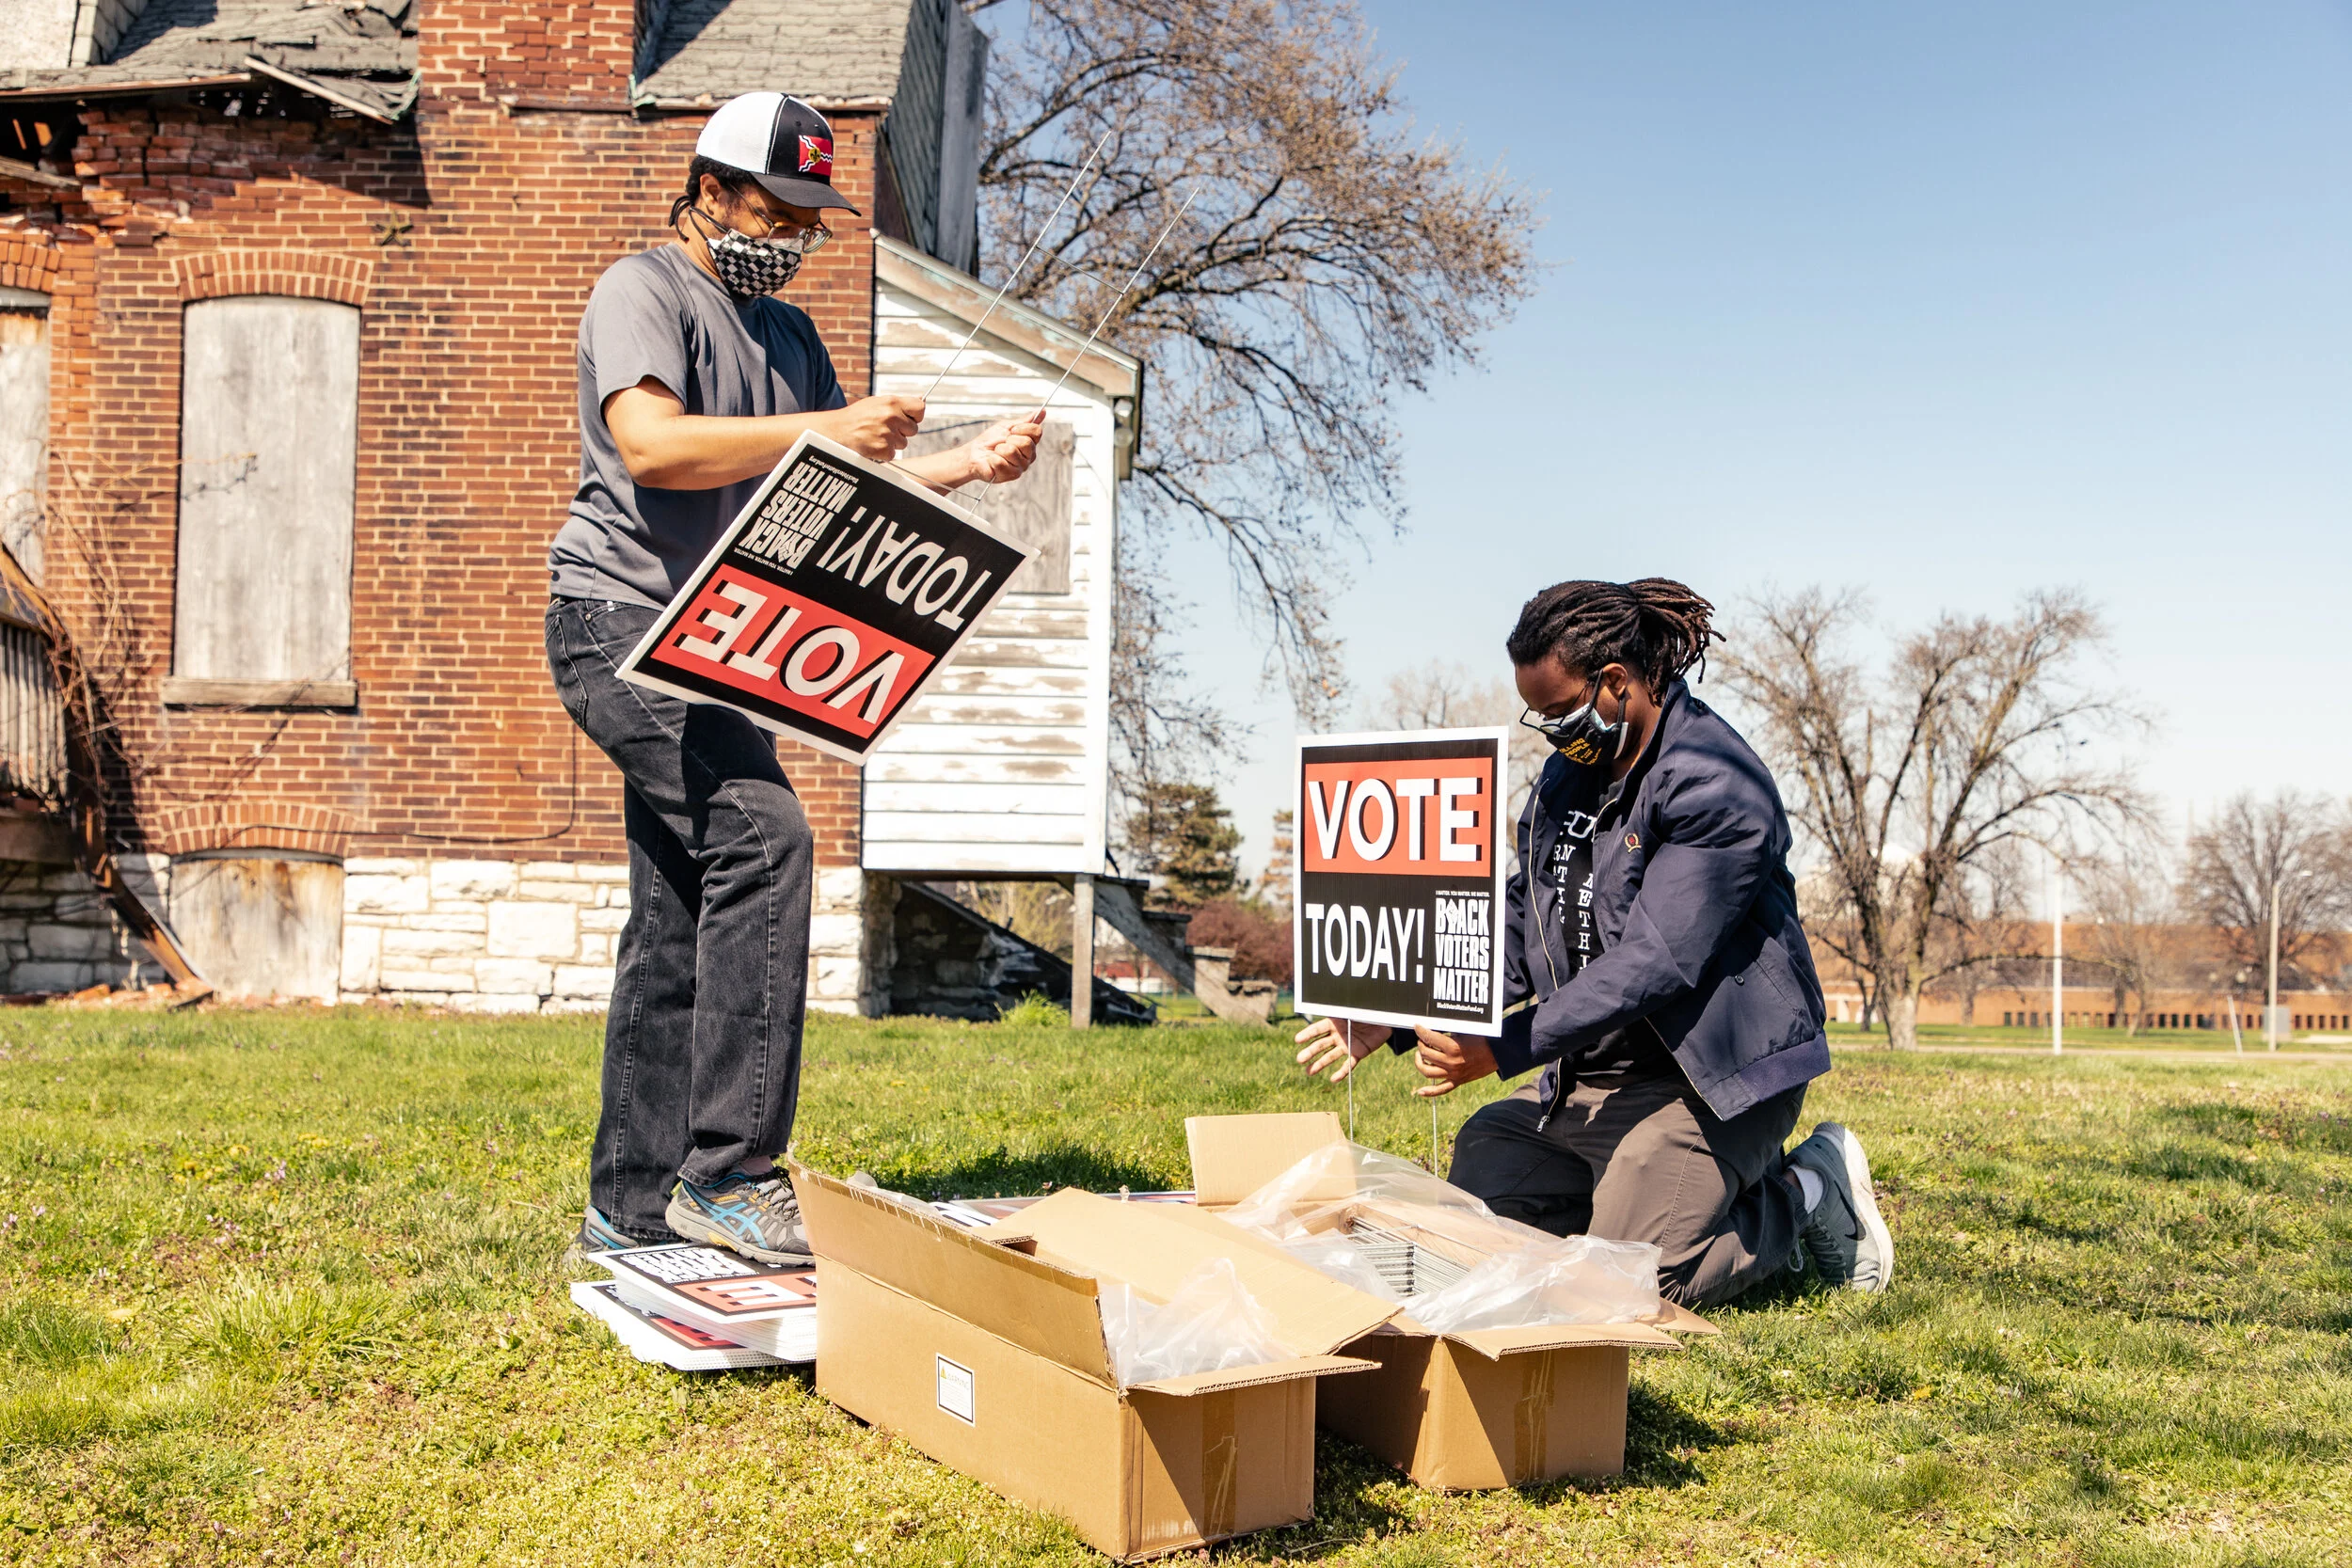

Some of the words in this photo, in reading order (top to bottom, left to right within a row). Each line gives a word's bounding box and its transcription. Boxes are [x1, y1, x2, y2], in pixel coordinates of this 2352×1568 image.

[782, 461, 857, 514] MATTER
[760, 488, 835, 541] VOTERS
[738, 515, 816, 569] BLACK
[816, 506, 992, 631] TODAY!
[674, 578, 905, 725] VOTE
[1308, 777, 1484, 862] VOTE
[1305, 902, 1425, 984] TODAY!
[1435, 897, 1489, 936] BLACK
[1435, 933, 1489, 970] VOTERS
[1433, 967, 1489, 1005] MATTER
